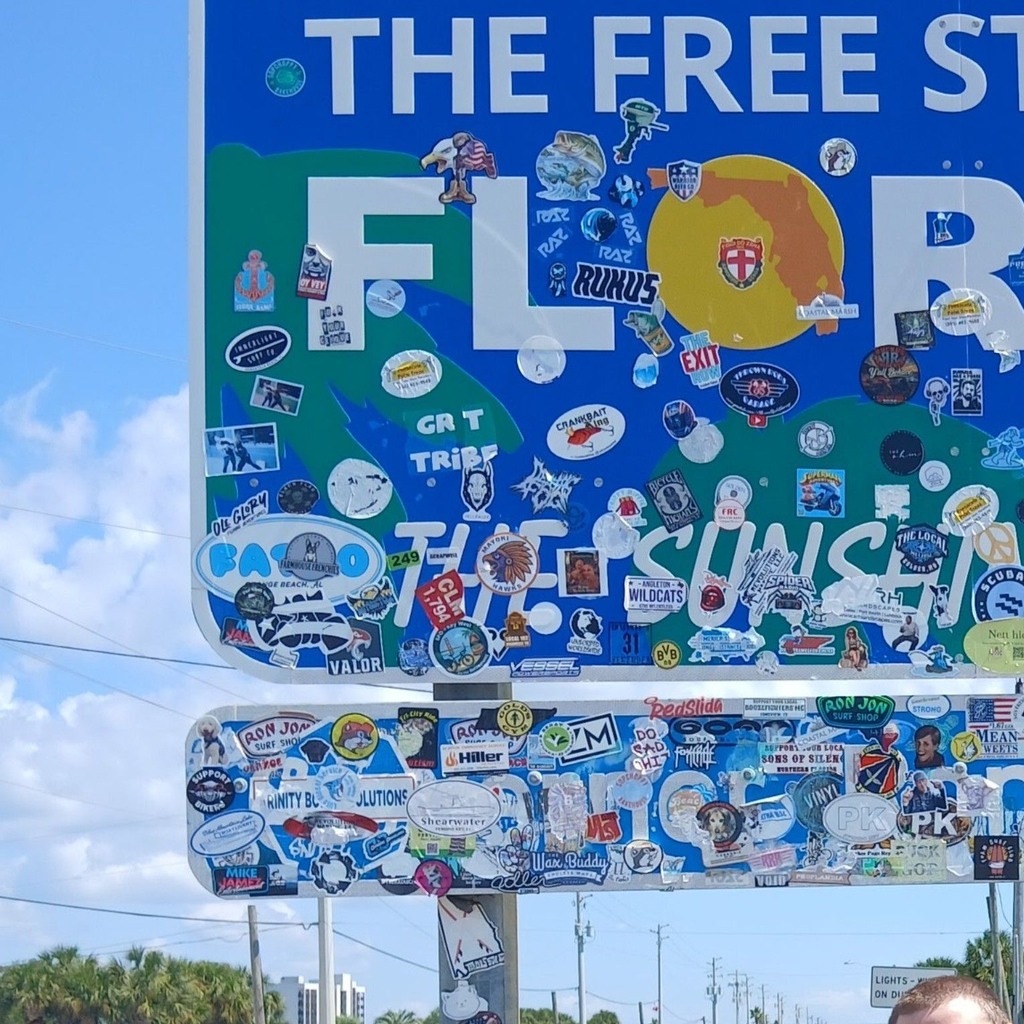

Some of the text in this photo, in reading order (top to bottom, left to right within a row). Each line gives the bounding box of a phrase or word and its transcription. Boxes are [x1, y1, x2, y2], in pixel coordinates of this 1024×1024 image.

[304, 17, 549, 115] THE
[593, 15, 879, 113] FREE
[574, 264, 659, 303] RUKUS
[683, 332, 711, 351] THE
[682, 345, 719, 374] EXIT
[555, 407, 607, 432] CRANKBAIT
[897, 530, 948, 556] THE LOCAL
[392, 551, 421, 568] 249
[492, 583, 523, 592] HAWKS
[767, 575, 812, 591] SPIDER
[980, 569, 1024, 593] SCUBA
[438, 577, 464, 617] CLM
[628, 588, 684, 604] WILDCATS
[423, 587, 452, 623] 1,794
[988, 629, 1010, 640] Nett
[657, 643, 679, 662] BVB
[329, 656, 383, 675] VALOR
[510, 658, 580, 671] VESSEL
[825, 696, 856, 714] RON
[857, 696, 889, 715] JON
[912, 705, 942, 714] STRONG
[832, 712, 879, 722] SURF SHOP
[244, 722, 276, 746] RON
[636, 728, 657, 742] DO
[974, 729, 1018, 743] MEAN
[254, 740, 276, 751] SURF
[459, 750, 504, 764] Hiller
[761, 754, 806, 765] SONS OF
[192, 768, 230, 786] SUPPORT
[264, 792, 300, 809] RINITY
[355, 788, 408, 808] OLUTIONS
[420, 816, 487, 827] Shearwater
[837, 806, 888, 832] PK
[911, 810, 959, 837] PK
[531, 851, 609, 876] Wax Buddy
[226, 867, 258, 878] MIKE
[875, 976, 908, 985] LIGHTS
[874, 990, 888, 999] ON
